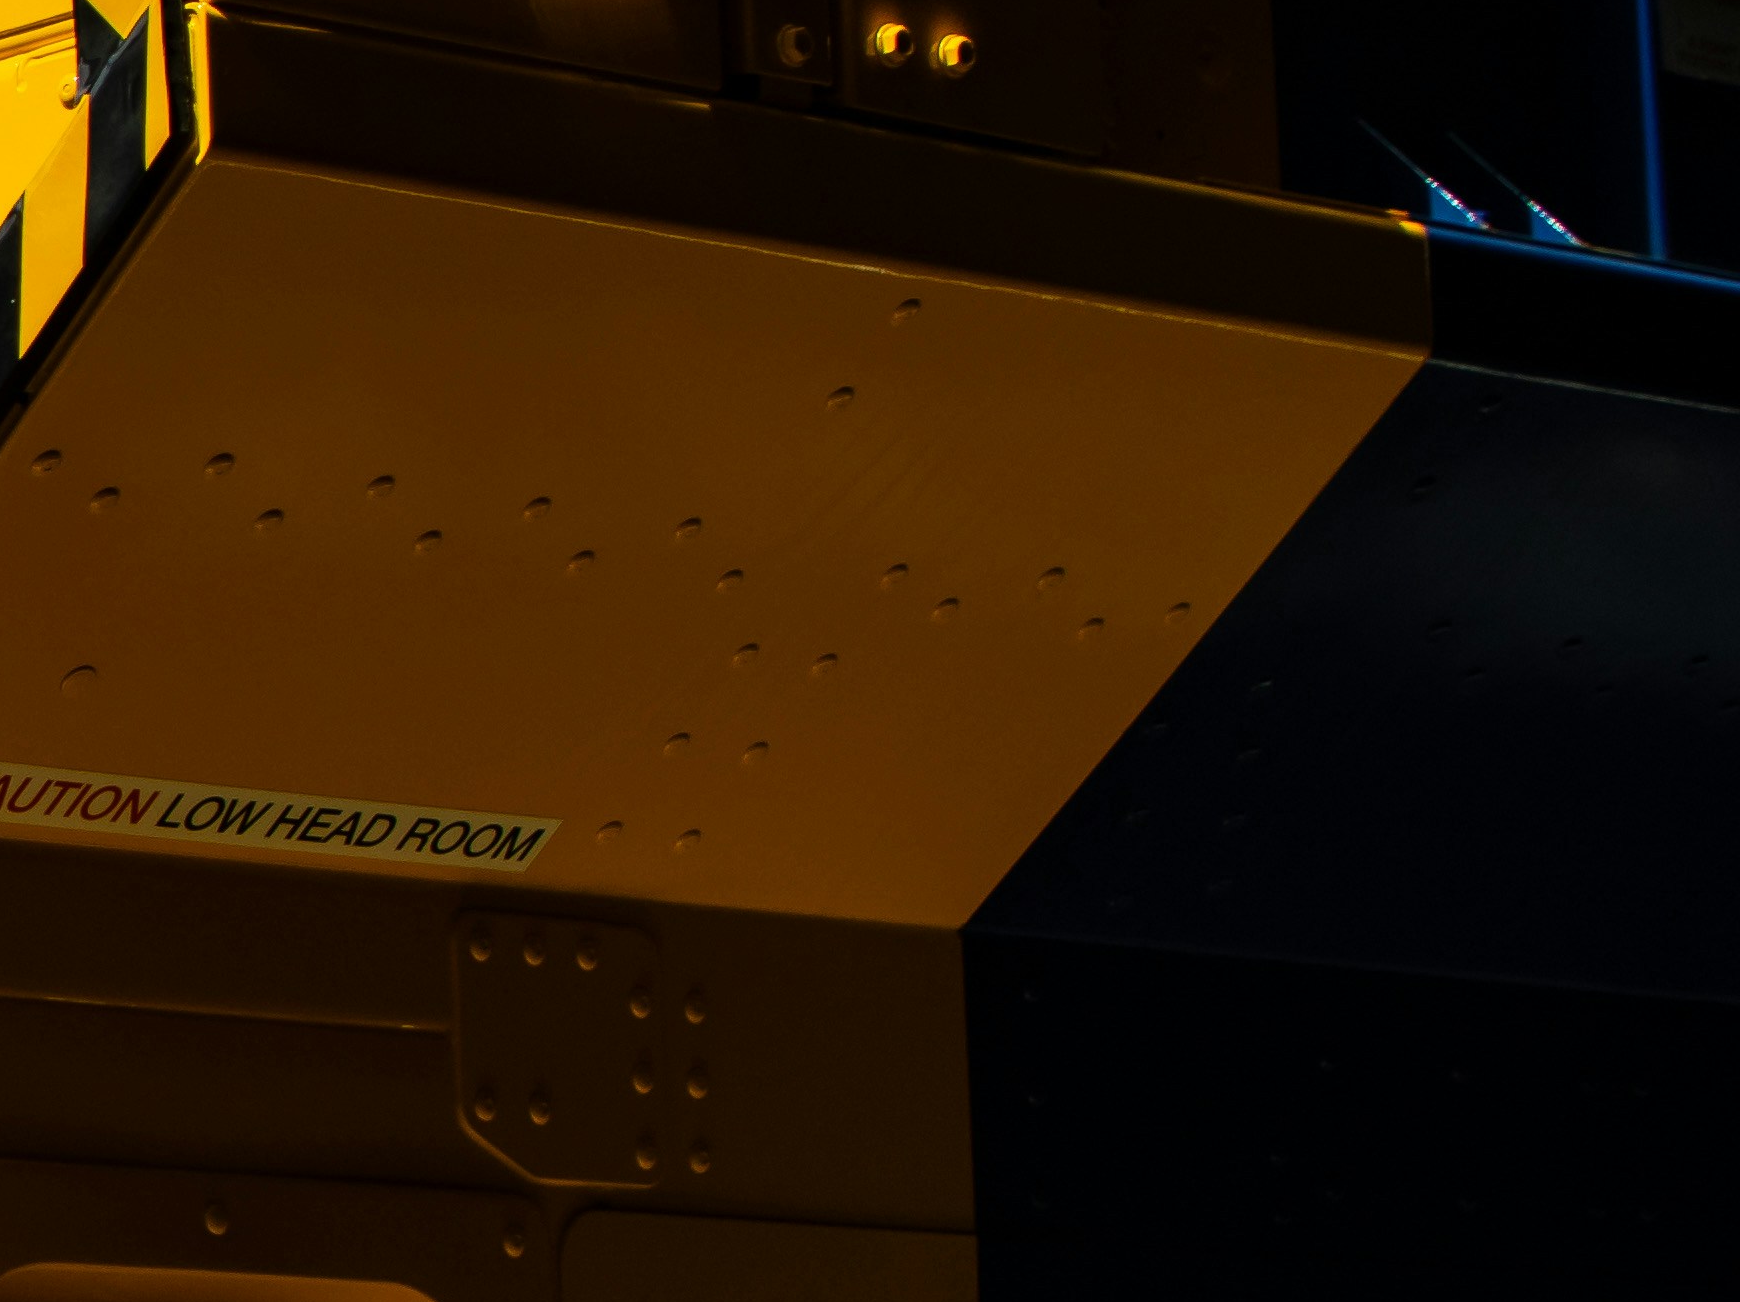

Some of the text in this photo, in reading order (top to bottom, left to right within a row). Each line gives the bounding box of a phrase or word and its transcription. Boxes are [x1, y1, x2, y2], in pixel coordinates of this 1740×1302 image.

[154, 793, 275, 837] LOW
[264, 804, 397, 848] HEAD
[395, 819, 546, 862] ROOM
